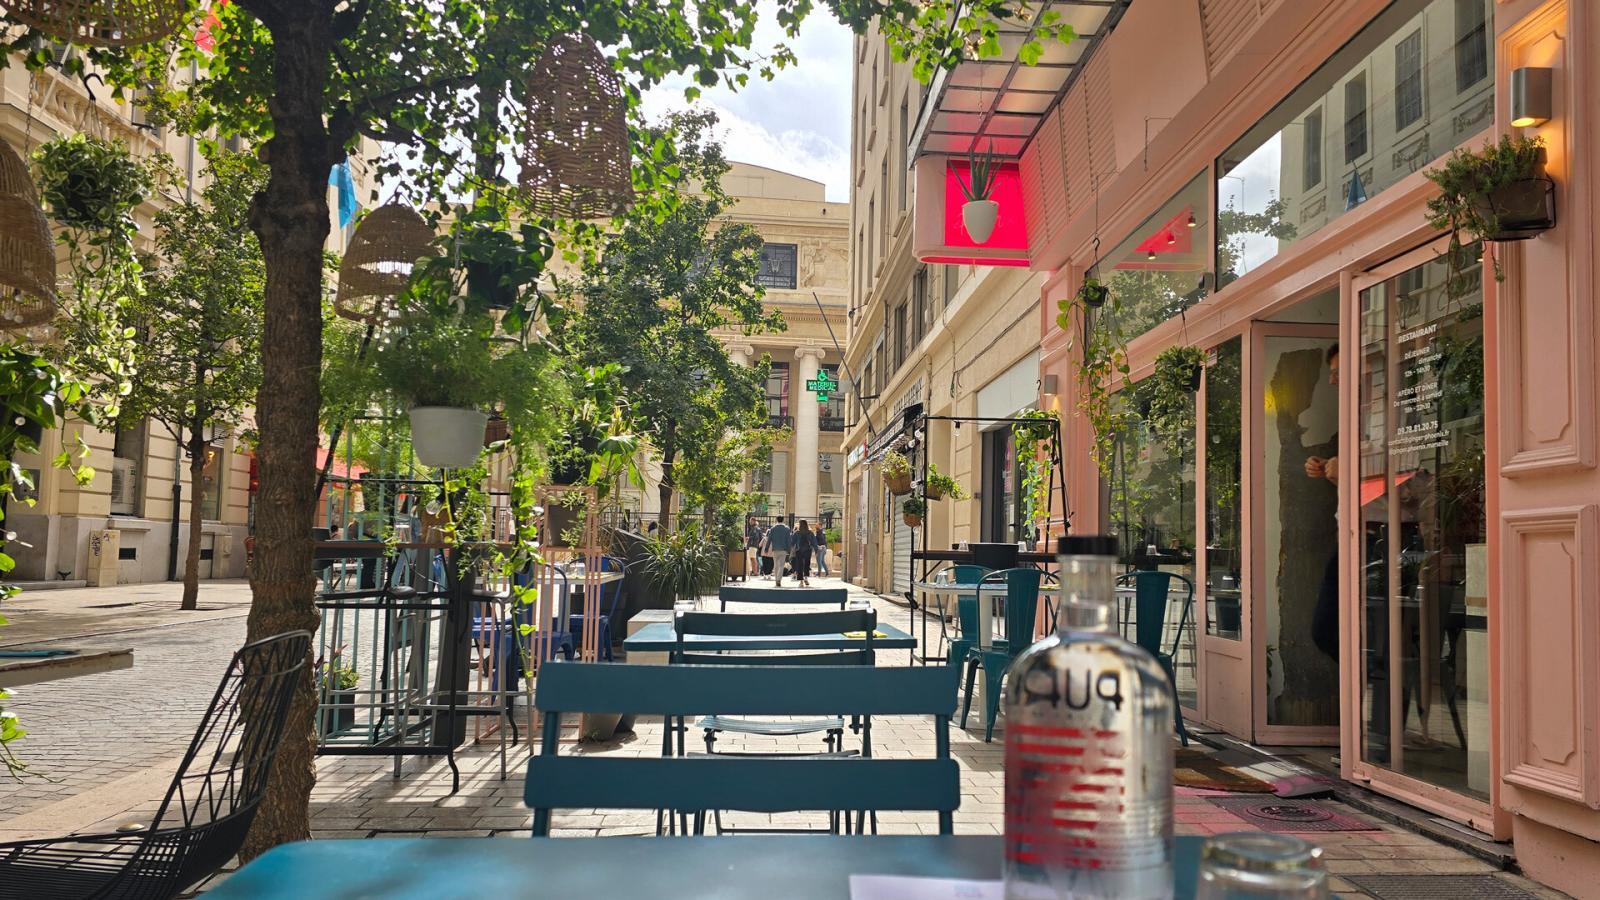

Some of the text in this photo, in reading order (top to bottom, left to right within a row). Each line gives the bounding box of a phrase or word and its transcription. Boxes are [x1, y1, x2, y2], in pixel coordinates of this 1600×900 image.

[1398, 324, 1437, 343] RESTAURANT
[1404, 346, 1430, 360] DÉJEUNER
[1418, 353, 1442, 365] dimanche
[1415, 385, 1422, 393] ET
[1393, 400, 1400, 408] De
